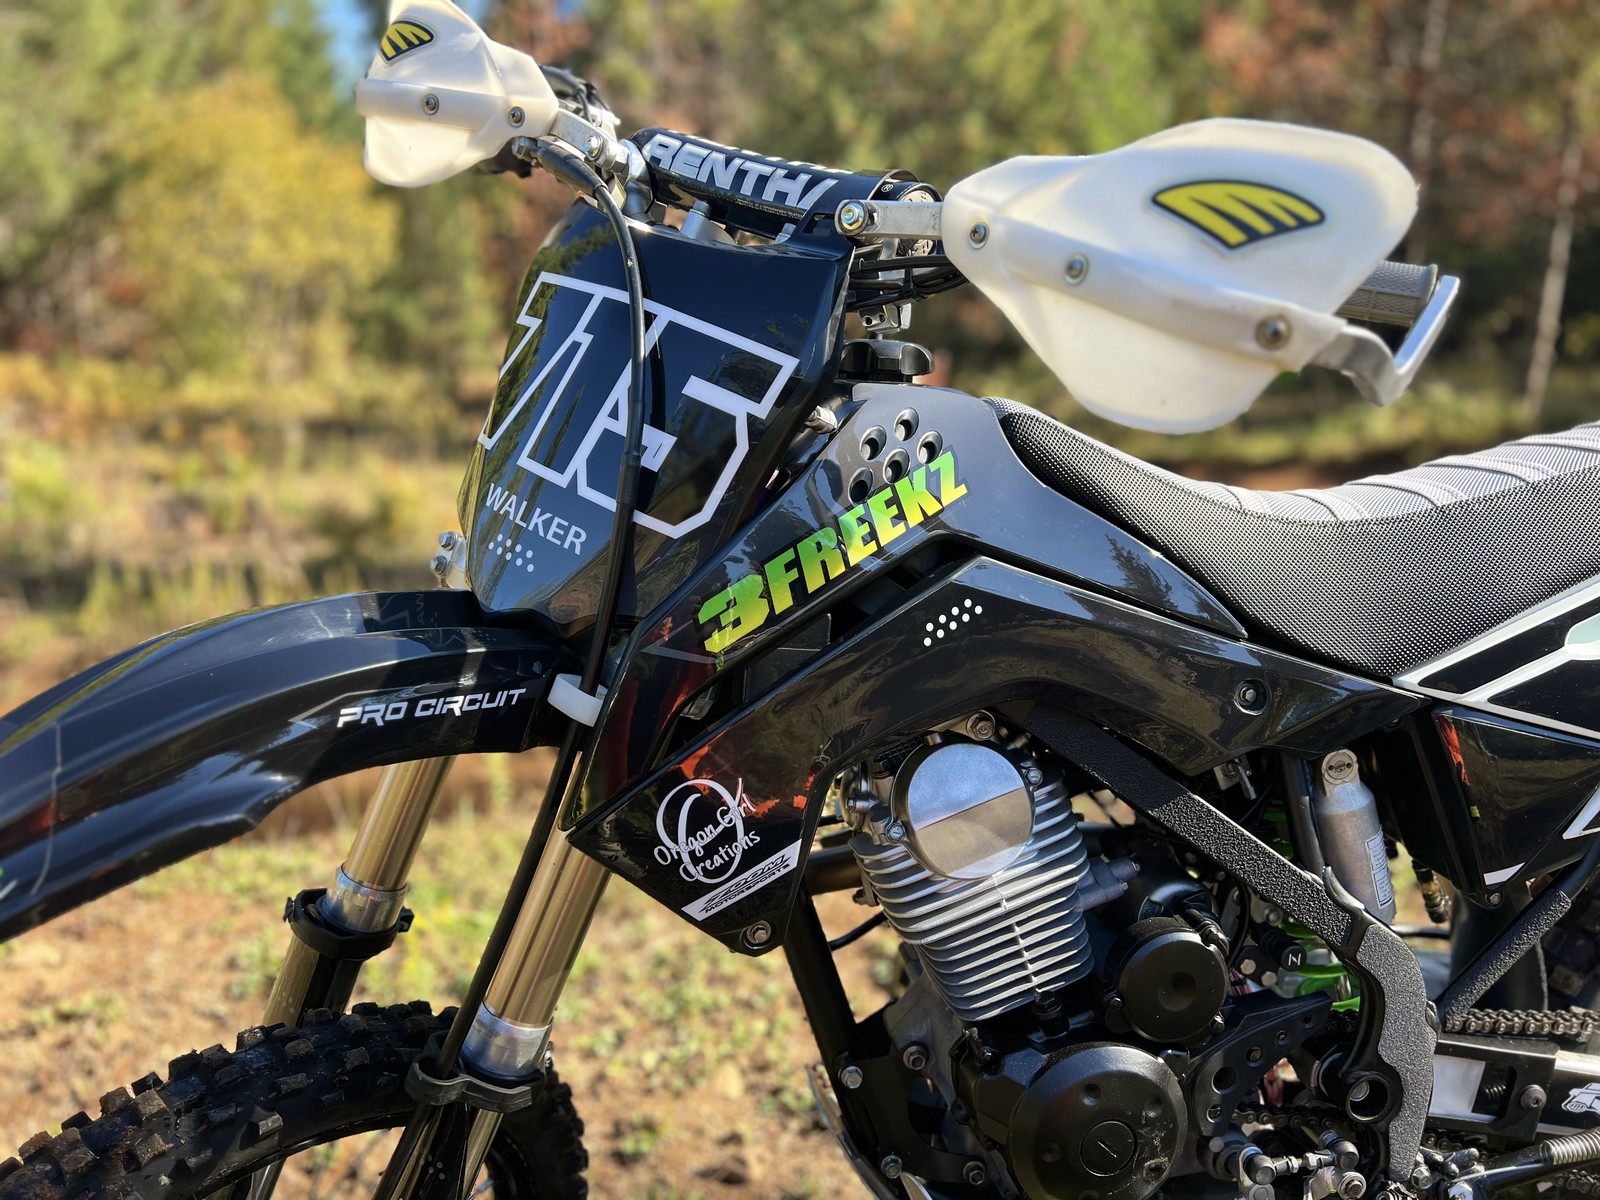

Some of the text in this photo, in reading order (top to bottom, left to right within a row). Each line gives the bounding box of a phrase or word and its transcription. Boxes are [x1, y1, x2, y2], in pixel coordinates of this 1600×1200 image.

[641, 133, 839, 209] RENTH
[485, 482, 588, 555] WALKER
[336, 688, 527, 728] PRO CIRCUIT
[653, 793, 757, 866] Oregon Girl
[679, 831, 761, 882] Creations
[705, 863, 790, 913] MOTORSPORTS
